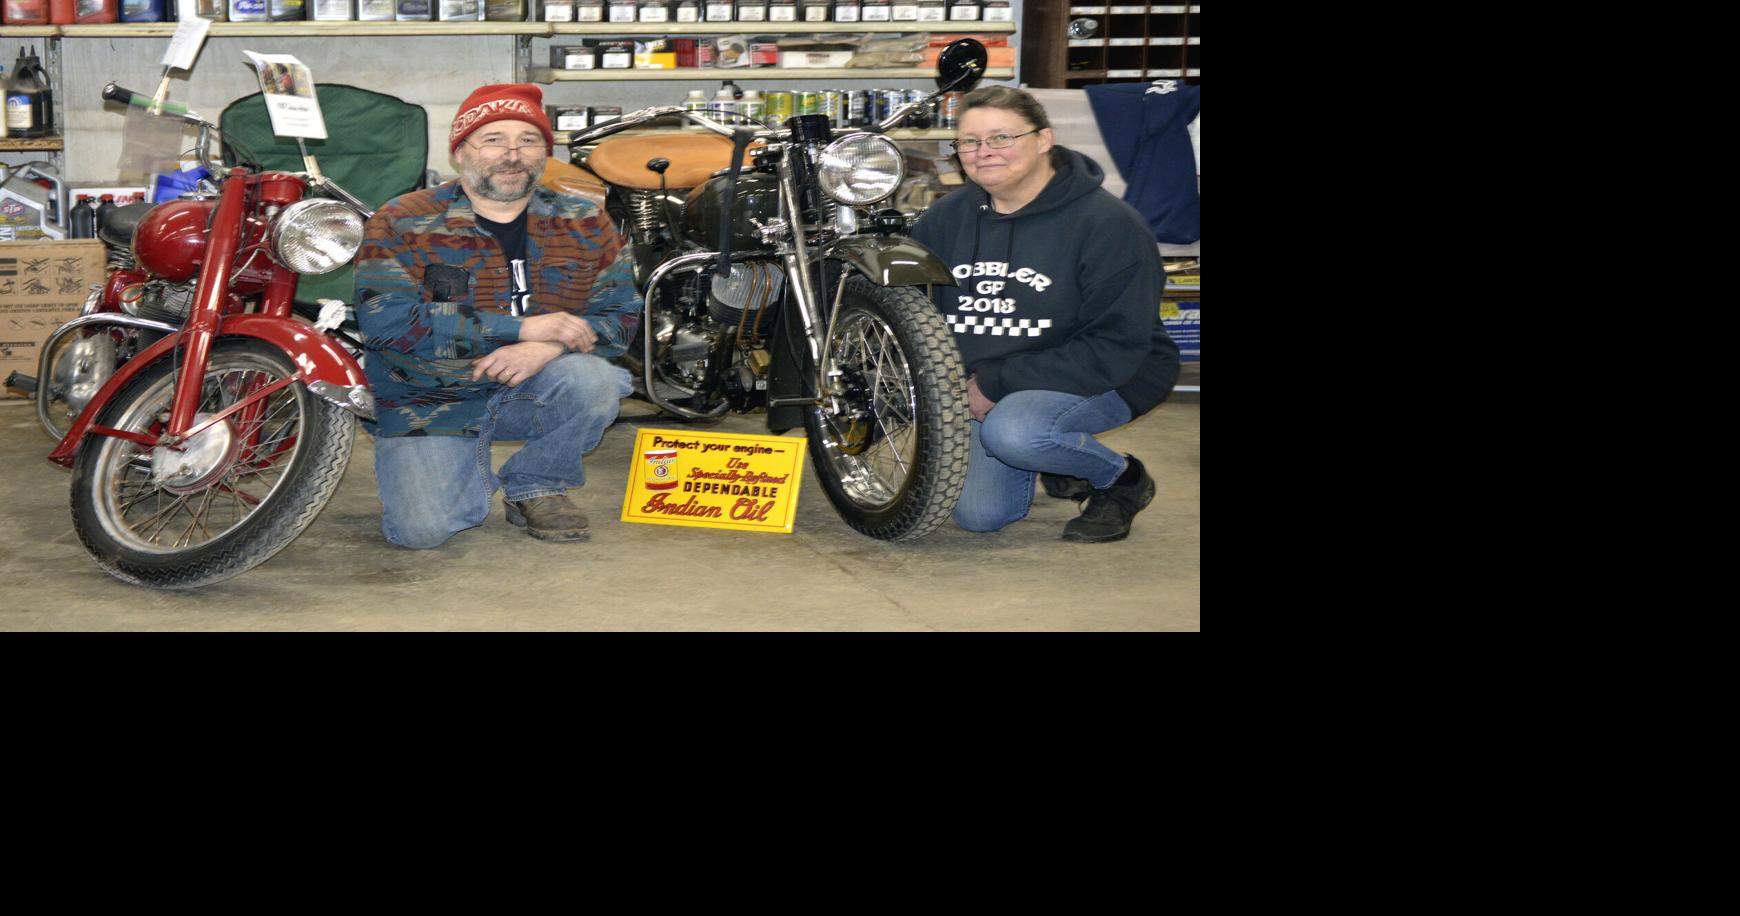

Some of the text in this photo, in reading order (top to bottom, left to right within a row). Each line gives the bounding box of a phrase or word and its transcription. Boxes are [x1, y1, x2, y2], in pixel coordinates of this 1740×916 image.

[449, 99, 536, 139] ODAKA
[950, 262, 1053, 292] OBBLER
[976, 280, 1006, 295] GP
[958, 295, 1016, 314] 2018
[652, 436, 700, 450] Protect
[701, 441, 732, 453] your
[726, 457, 750, 470] Use
[682, 481, 778, 498] DEPENDABLE
[640, 492, 775, 522] Indian Oil
